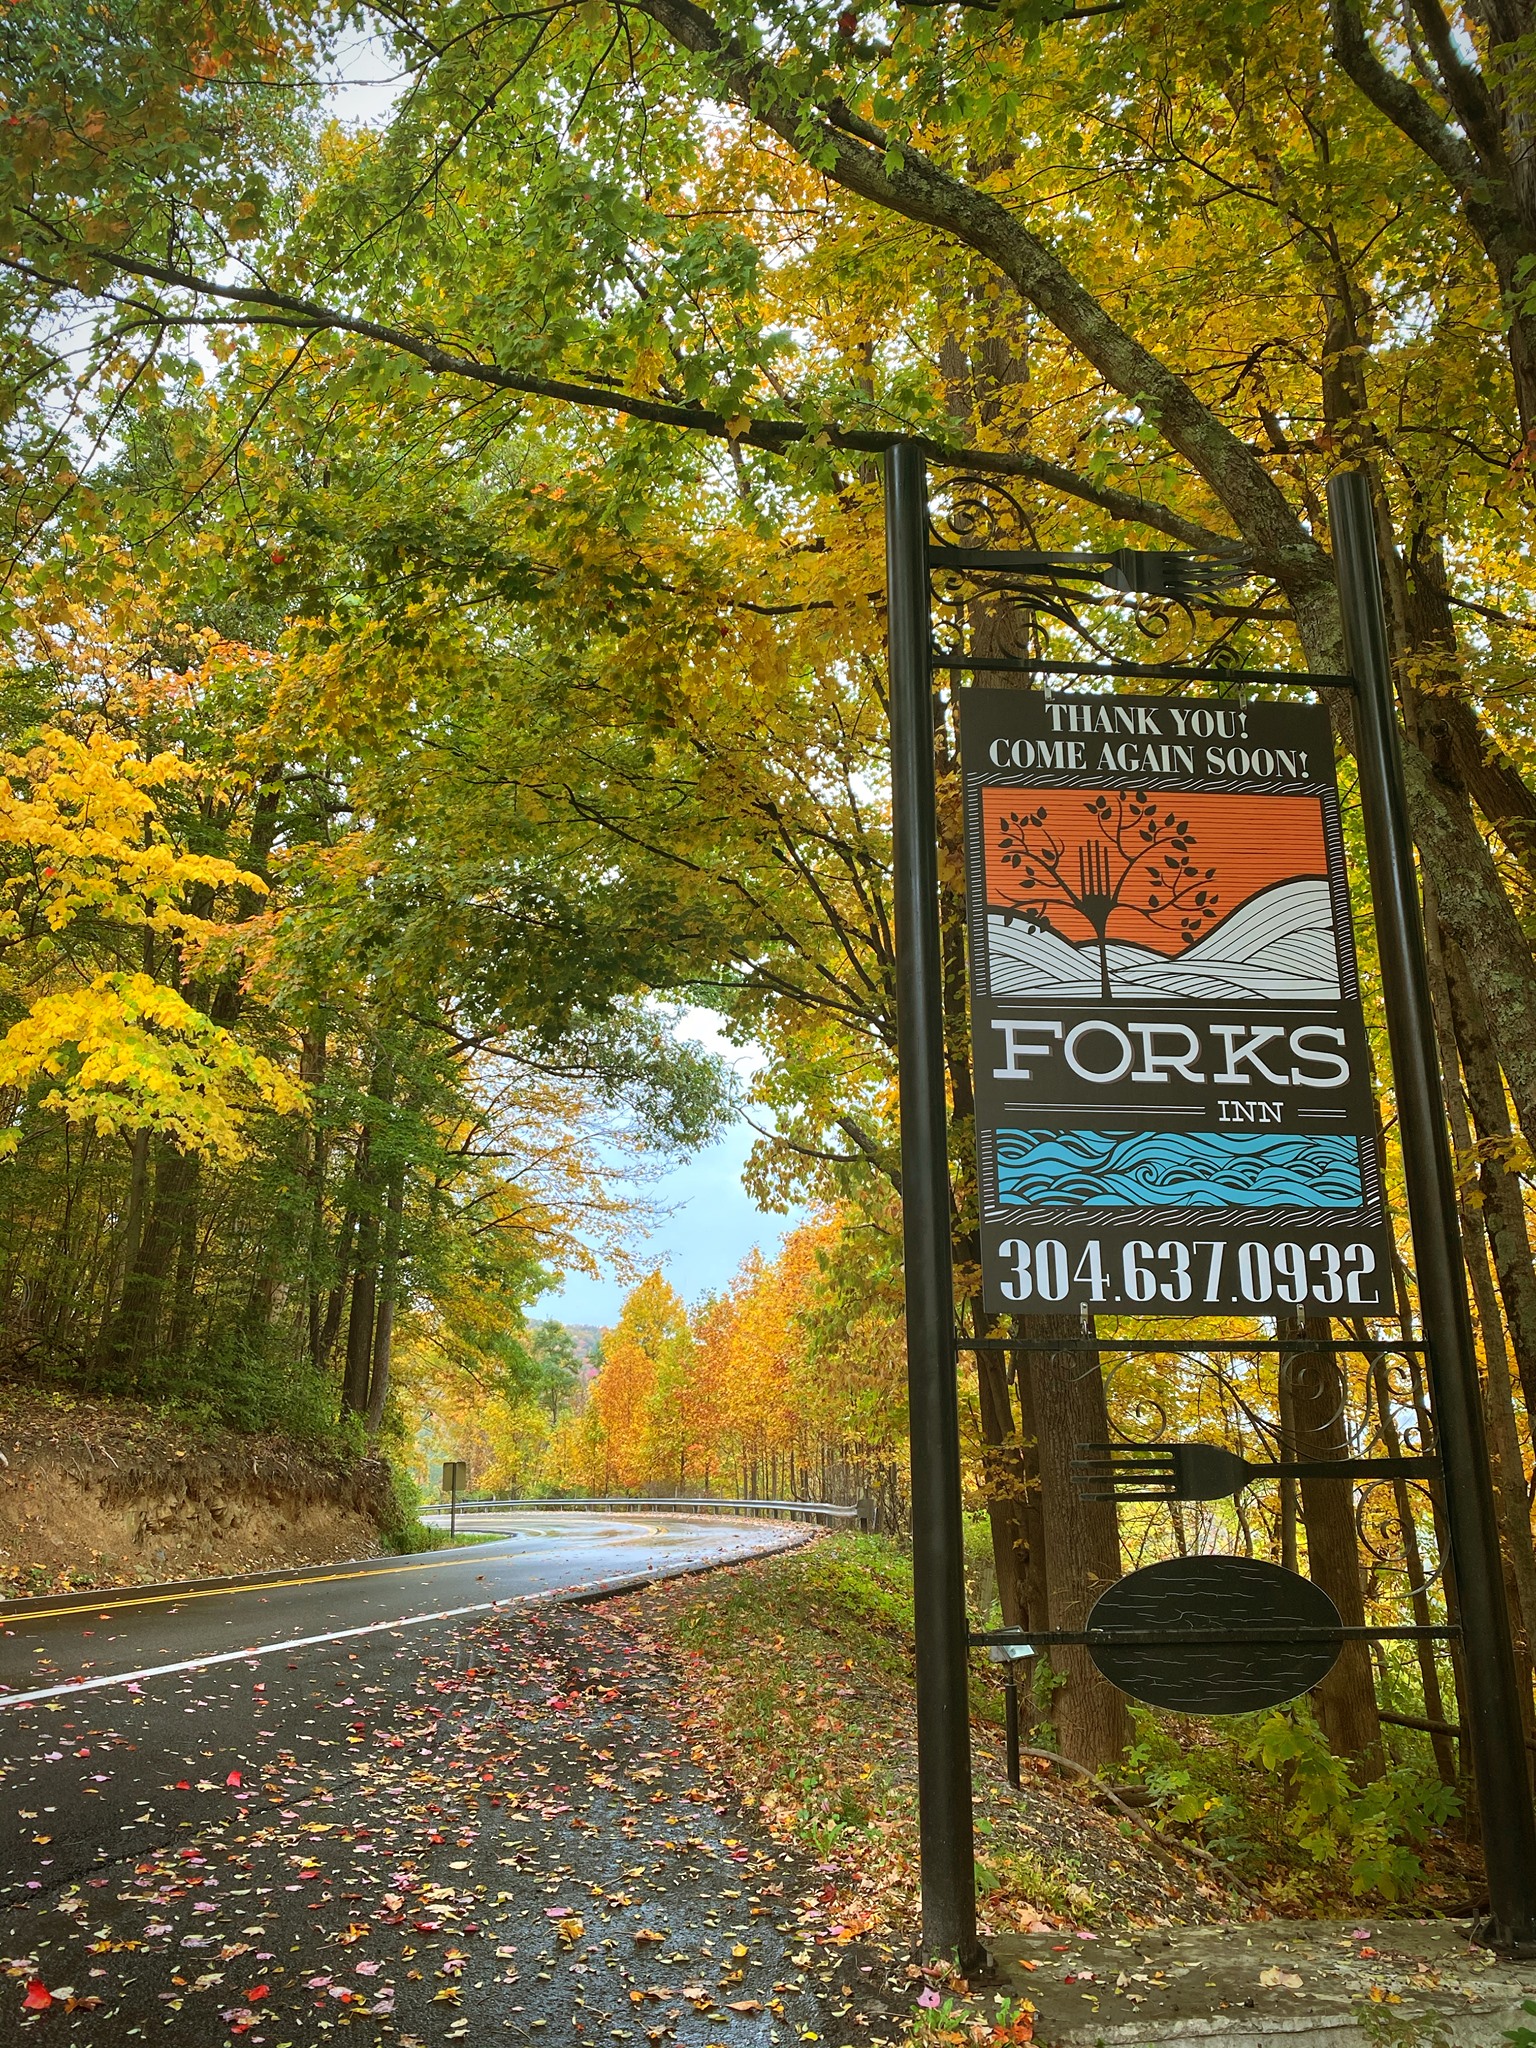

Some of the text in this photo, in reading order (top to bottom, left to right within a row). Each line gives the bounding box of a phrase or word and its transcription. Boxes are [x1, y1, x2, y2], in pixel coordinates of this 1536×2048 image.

[1045, 704, 1249, 739] THANK YOU!
[989, 738, 1310, 778] COME AGAIN SOON!
[991, 1020, 1351, 1088] FORKS
[1217, 1100, 1284, 1123] INN
[998, 1238, 1379, 1304] 304.637.0932
